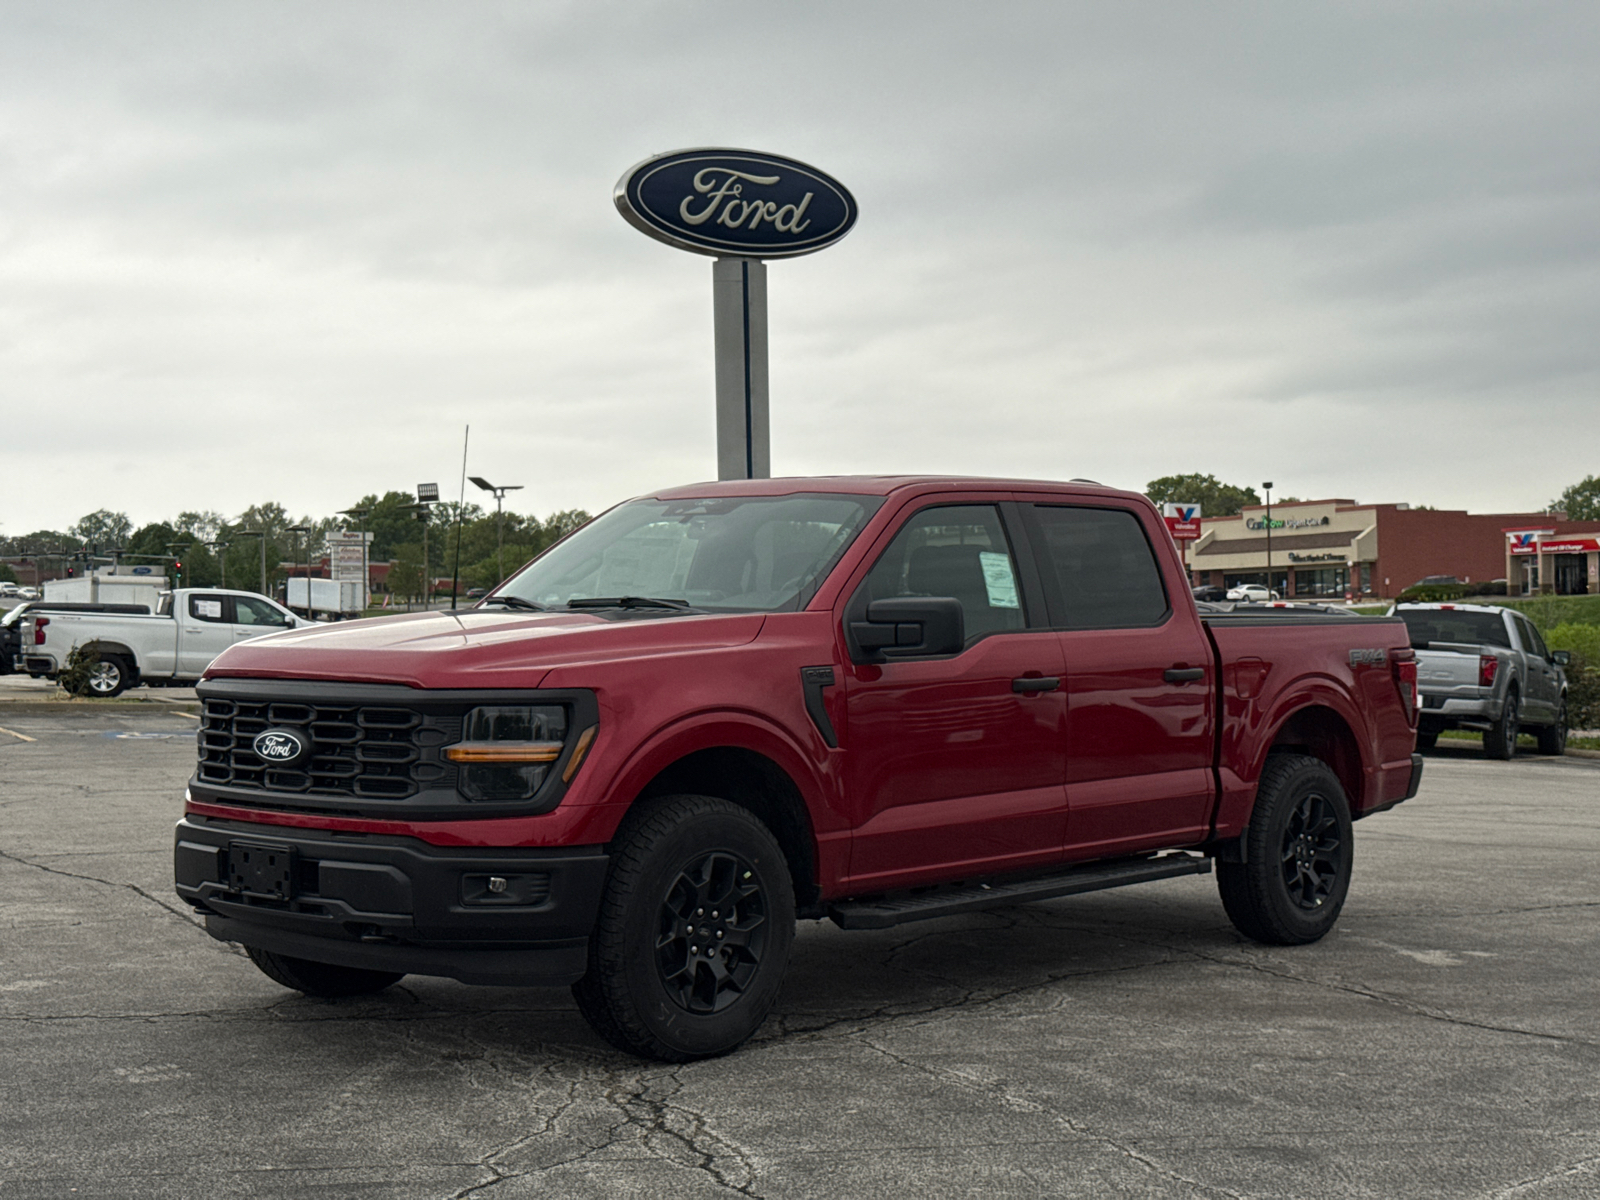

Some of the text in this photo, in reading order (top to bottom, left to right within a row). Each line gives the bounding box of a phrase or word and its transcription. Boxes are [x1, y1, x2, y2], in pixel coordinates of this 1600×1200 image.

[679, 167, 814, 235] Ford
[1350, 648, 1385, 668] FX4
[262, 736, 291, 757] Ford
